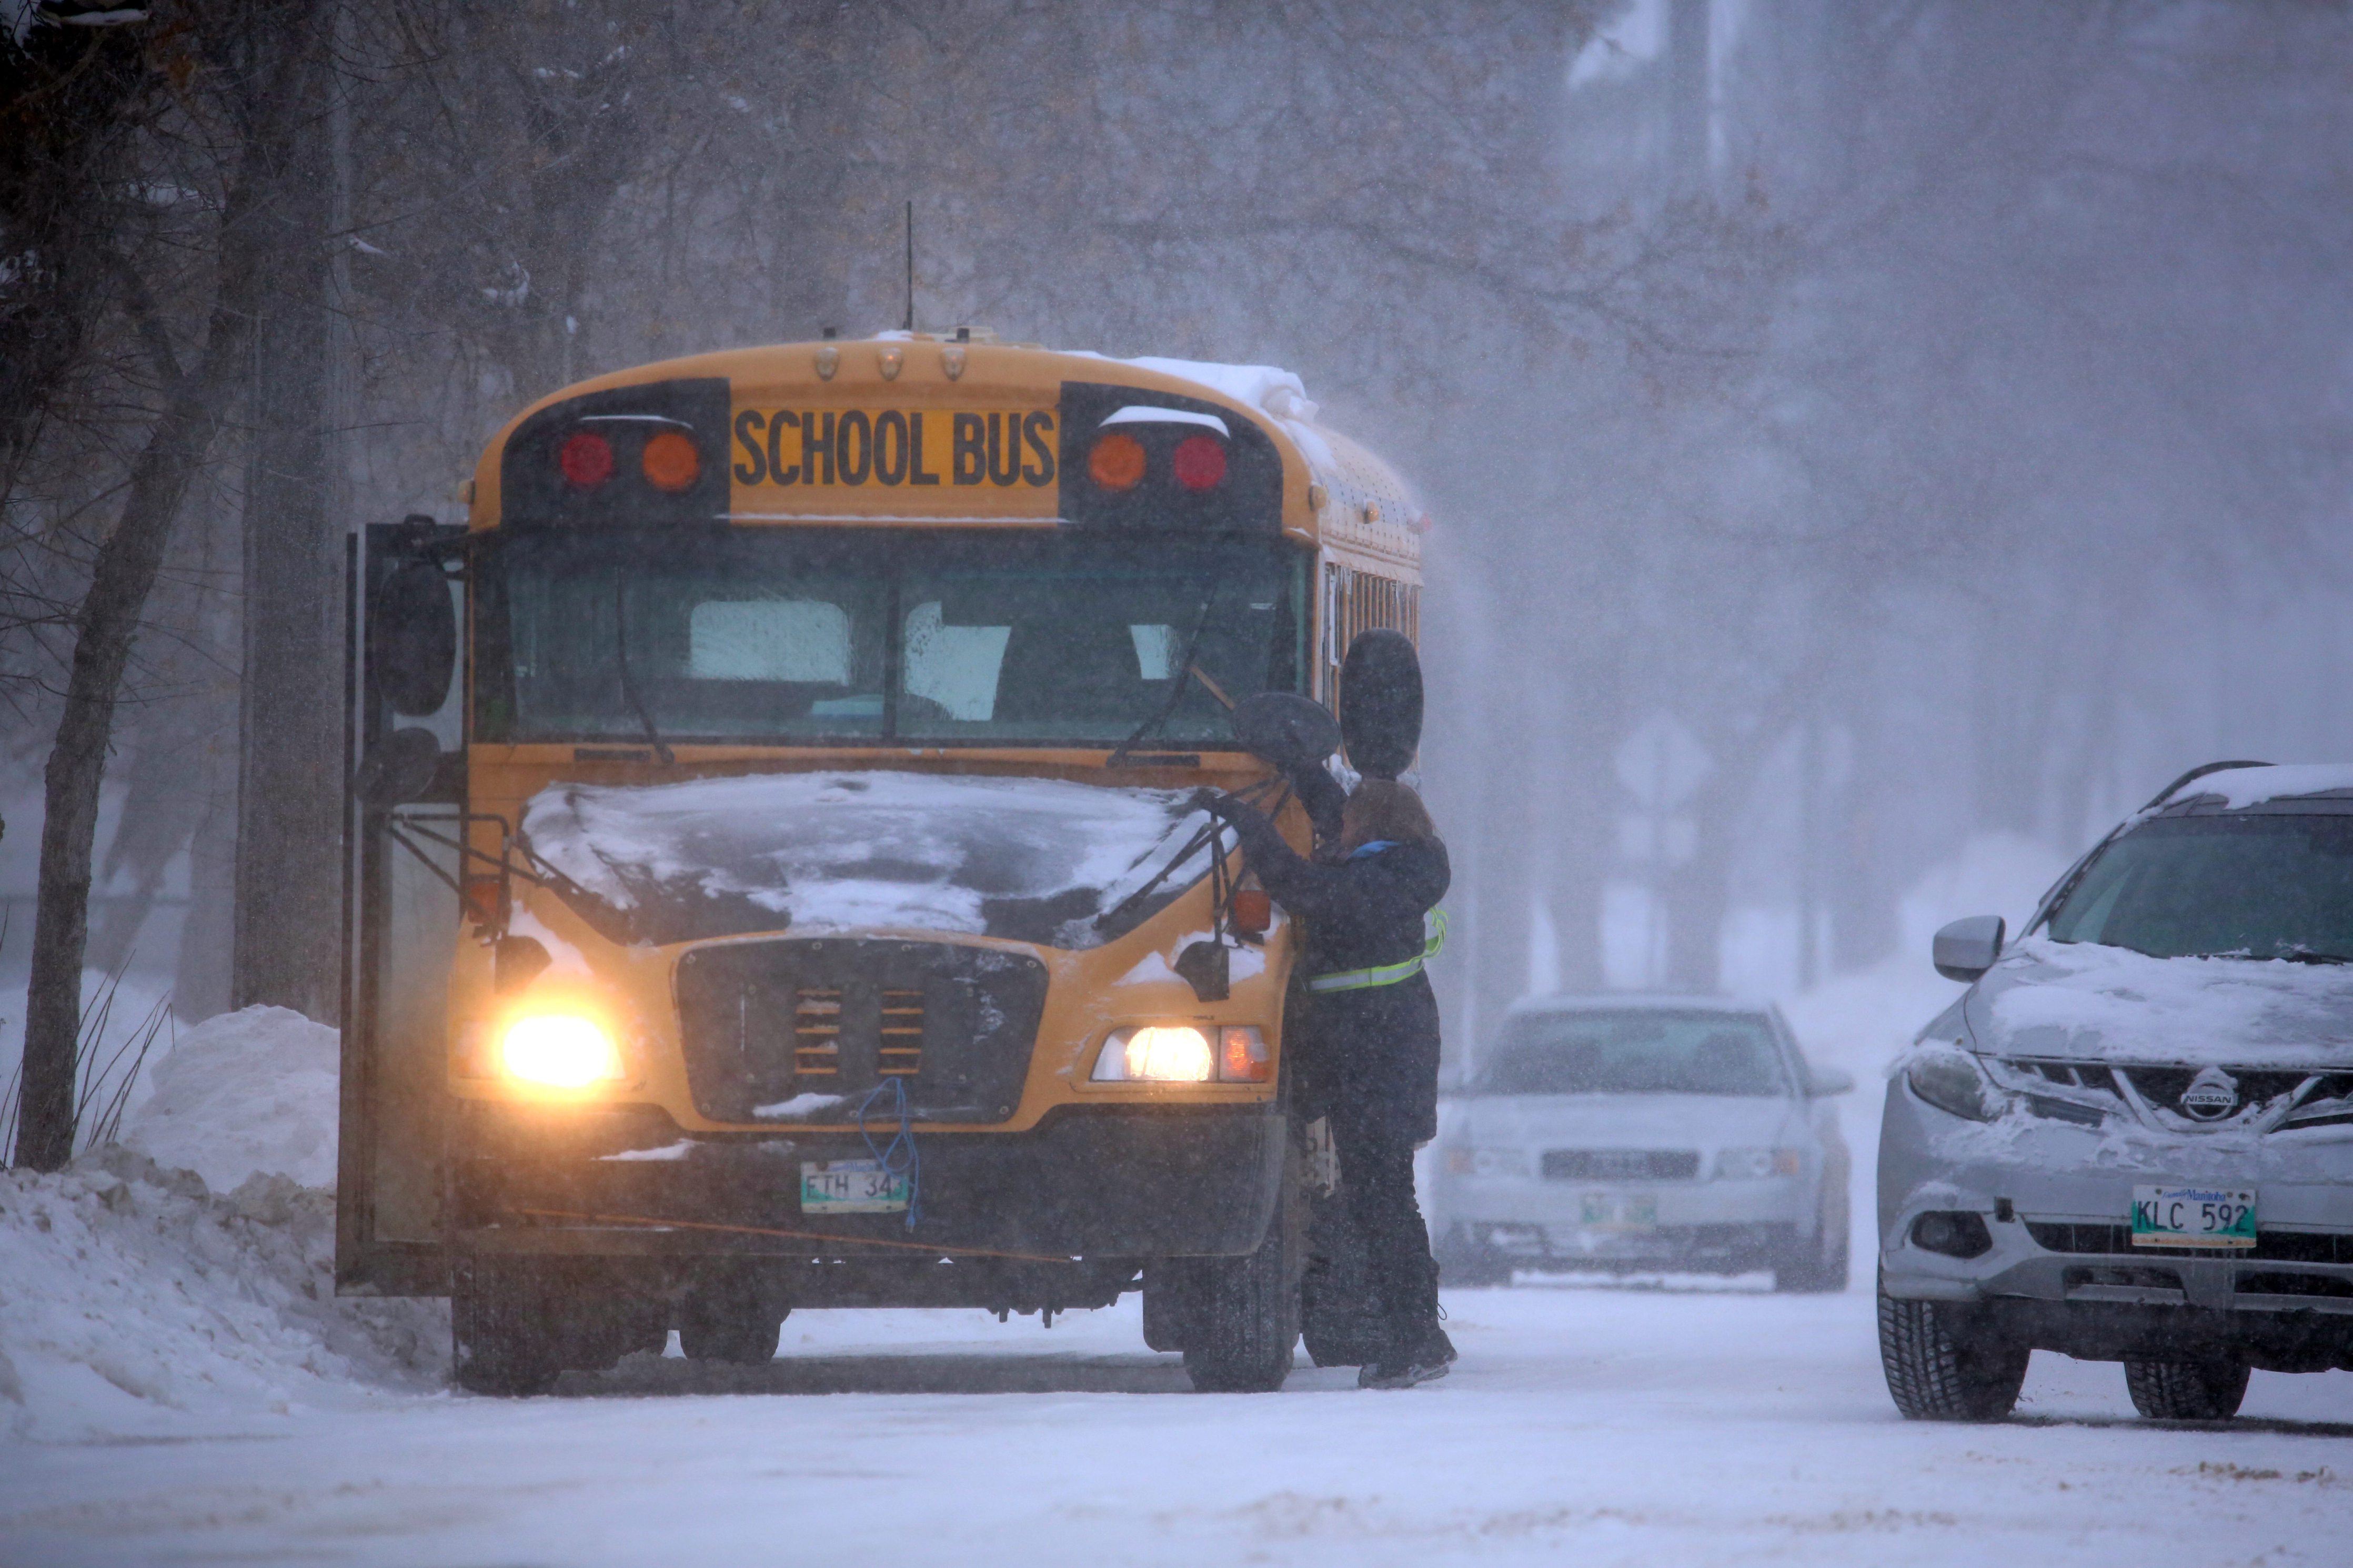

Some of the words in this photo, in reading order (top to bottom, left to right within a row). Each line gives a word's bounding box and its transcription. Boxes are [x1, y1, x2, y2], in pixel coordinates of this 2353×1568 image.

[734, 410, 940, 486] SCHOOL
[953, 411, 1055, 487] BUS
[806, 1175, 849, 1198] ETH
[2187, 1189, 2225, 1201] Manitoba
[2137, 1201, 2184, 1229] KLC
[2201, 1203, 2249, 1232] 592
